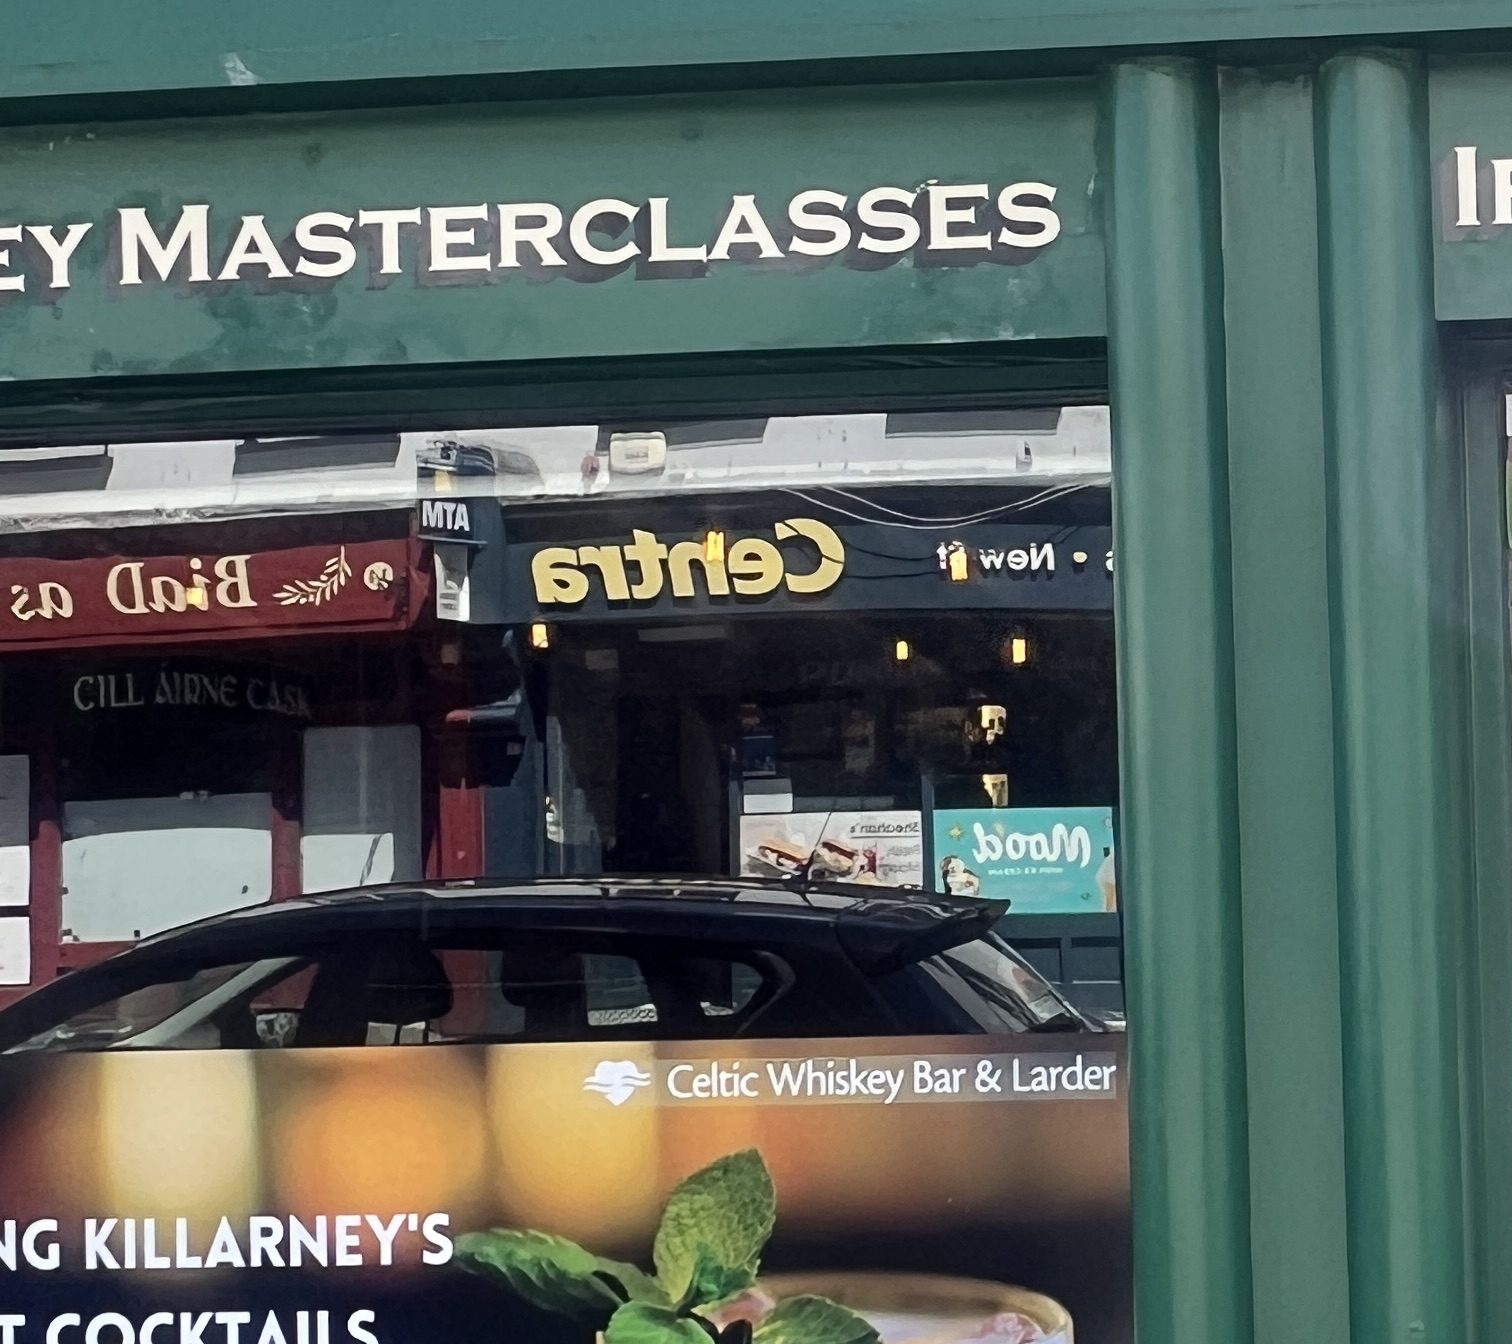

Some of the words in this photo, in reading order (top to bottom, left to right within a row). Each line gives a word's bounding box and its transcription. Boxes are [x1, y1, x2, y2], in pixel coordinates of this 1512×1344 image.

[118, 181, 1063, 286] MASTERCLASSES
[666, 1058, 760, 1099] Celtic
[768, 1057, 904, 1105] Whiskey
[912, 1059, 968, 1095] Bar
[974, 1059, 1003, 1094] &
[1012, 1054, 1117, 1094] Larder
[83, 1212, 455, 1271] KILLARNEY'S
